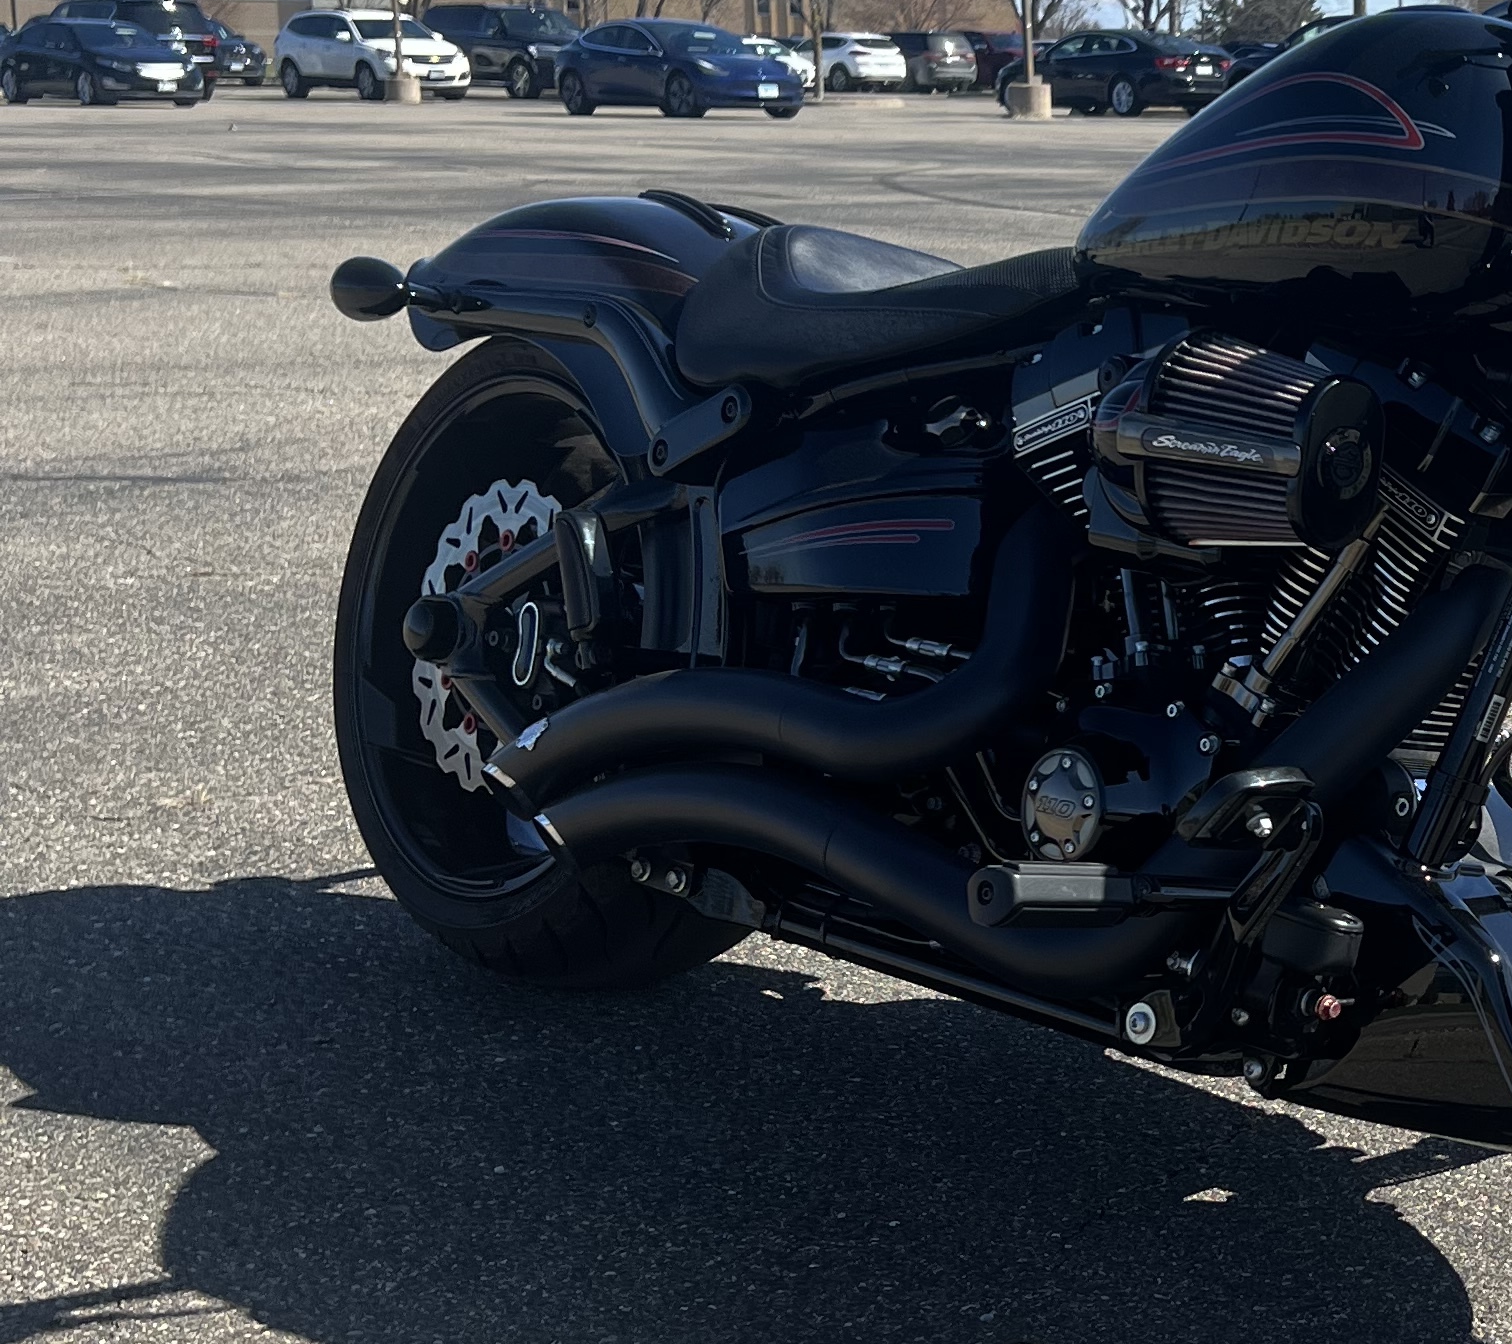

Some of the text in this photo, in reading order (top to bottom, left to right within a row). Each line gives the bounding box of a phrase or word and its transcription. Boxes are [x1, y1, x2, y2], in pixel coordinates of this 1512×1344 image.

[1100, 218, 1412, 252] ARLEY-DAVIDSON
[1220, 443, 1264, 464] Eagle
[1395, 492, 1428, 518] 110
[1036, 795, 1076, 819] 110
